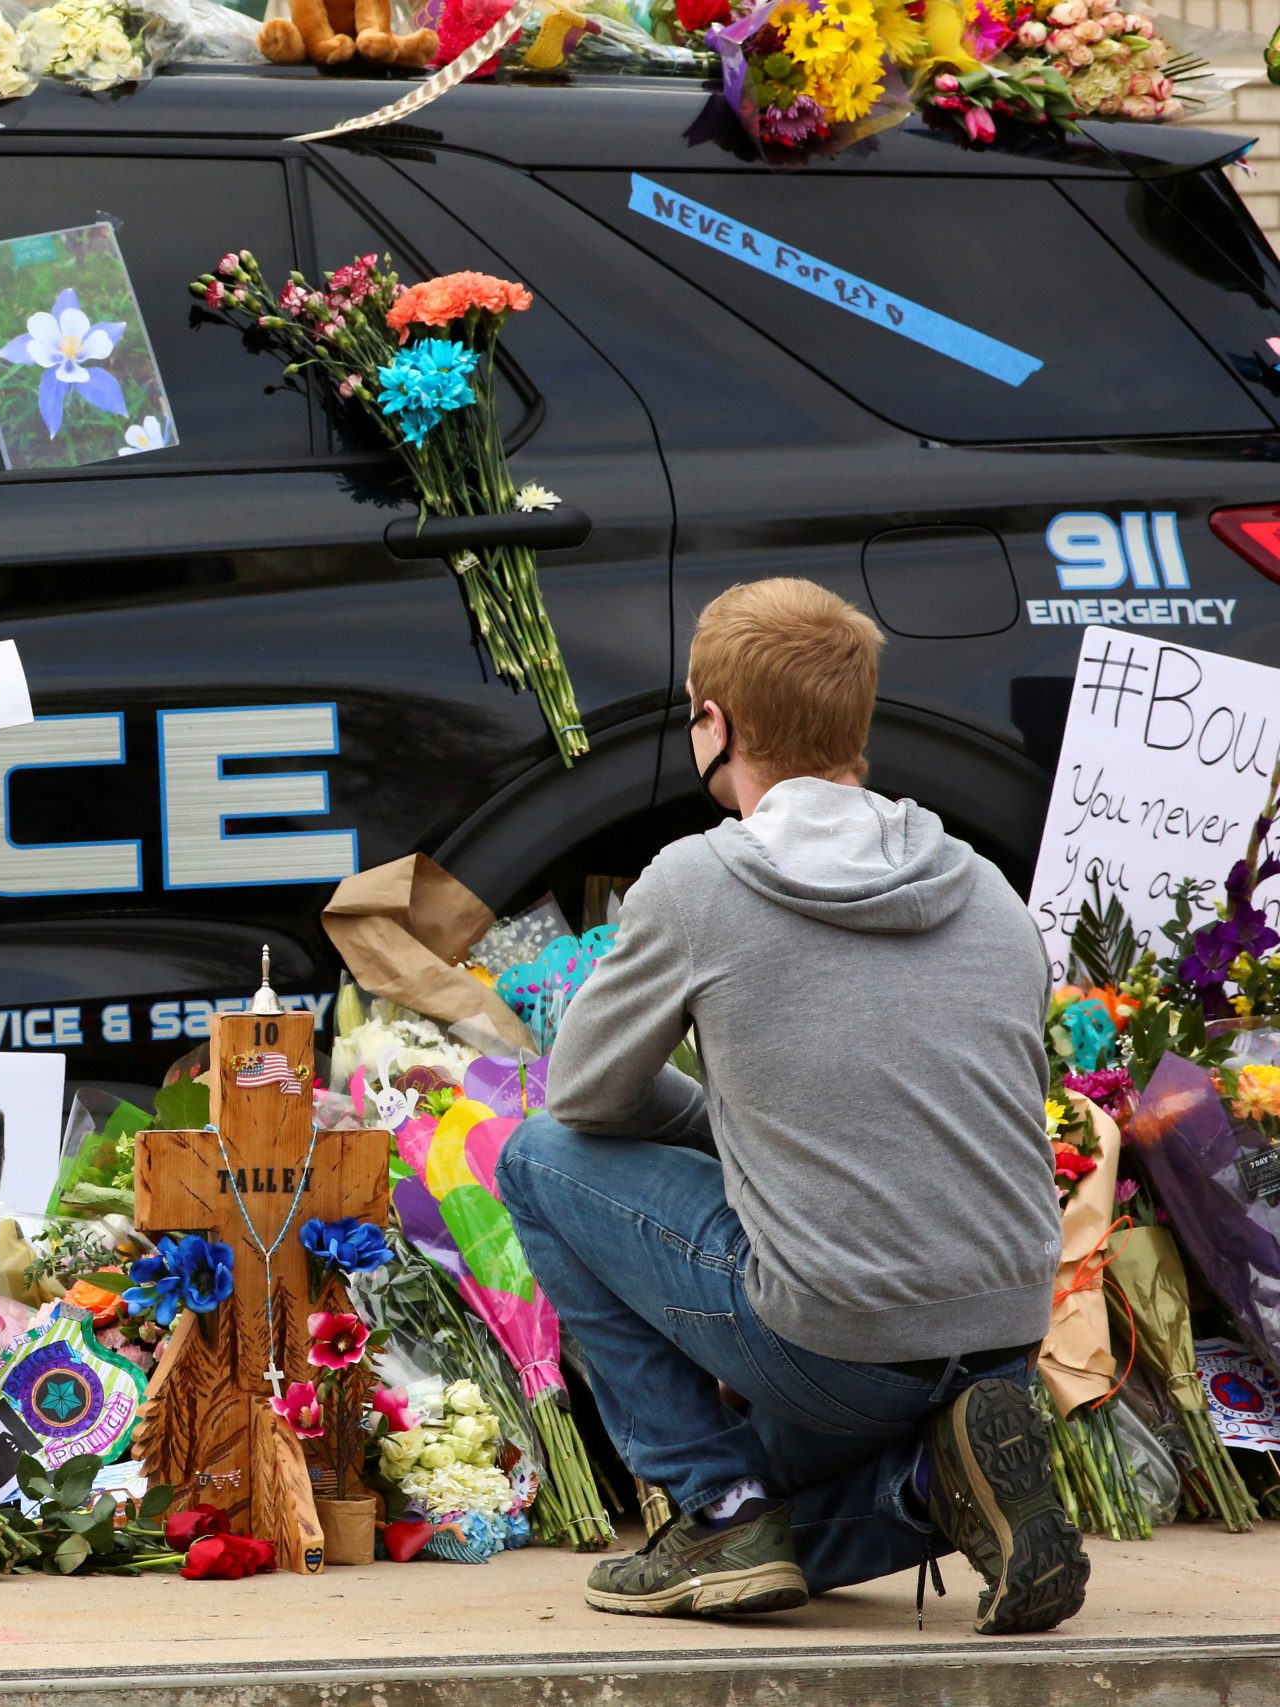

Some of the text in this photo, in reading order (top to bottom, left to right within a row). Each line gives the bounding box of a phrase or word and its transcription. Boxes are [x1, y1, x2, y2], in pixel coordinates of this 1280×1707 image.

[653, 191, 761, 256] NEVER
[1045, 511, 1191, 590] 911
[1025, 598, 1238, 625] EMERGENCY
[1064, 764, 1239, 847] You never
[1055, 844, 1130, 897] you
[102, 1001, 132, 1043] &
[254, 1021, 279, 1046] 10
[216, 1166, 316, 1194] TALLEY
[1255, 1156, 1269, 1168] DAY
[8, 1343, 67, 1393] OFFICER
[1201, 1379, 1244, 1418] INTEGRITY
[52, 1400, 128, 1464] POLICE
